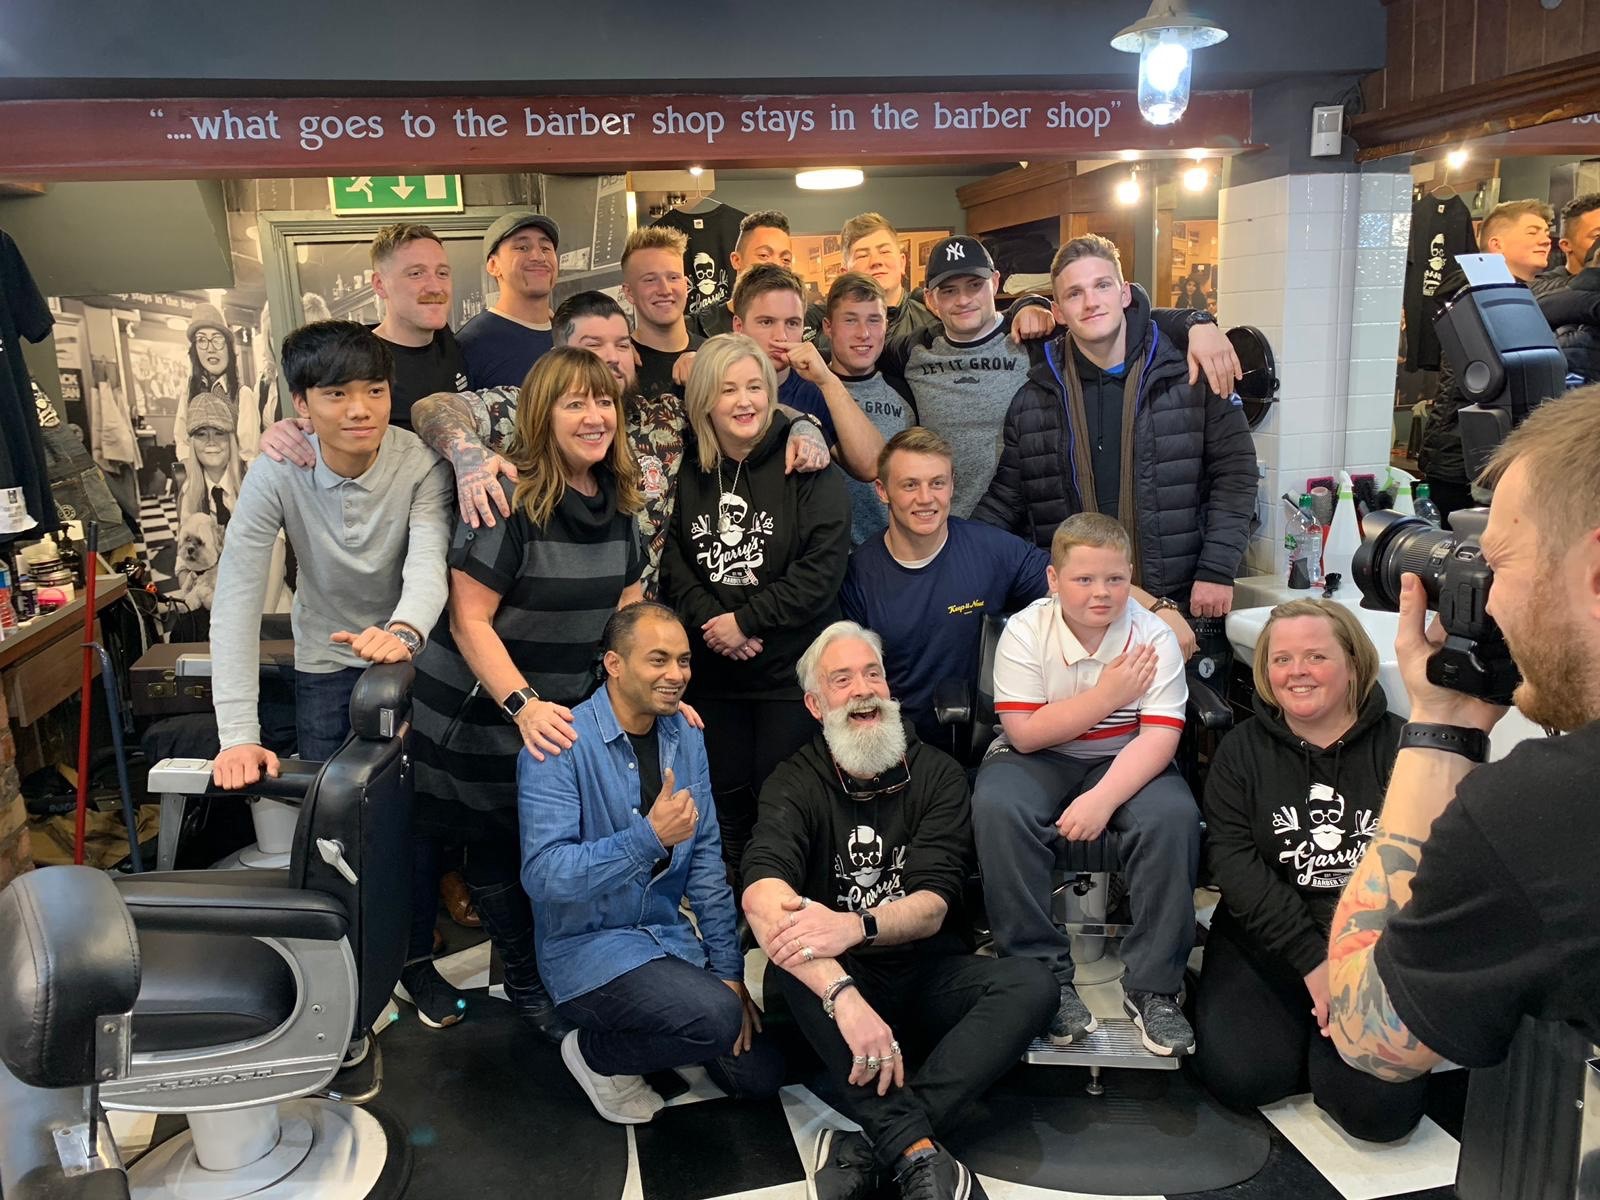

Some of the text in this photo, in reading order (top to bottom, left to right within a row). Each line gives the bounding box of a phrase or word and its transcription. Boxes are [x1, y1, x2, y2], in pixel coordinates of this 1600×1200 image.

[299, 115, 385, 150] goes
[400, 110, 436, 138] to
[453, 107, 508, 138] the
[523, 106, 636, 137] barber
[652, 105, 725, 144] shop
[740, 104, 816, 142] stays
[830, 103, 856, 131] in
[871, 102, 919, 130] the
[933, 101, 1032, 129] barber
[945, 242, 966, 261] NY
[920, 357, 1018, 376] LET IT GROW
[865, 401, 902, 418] GROW
[697, 536, 760, 582] Garry's
[1279, 840, 1367, 886] Garry's
